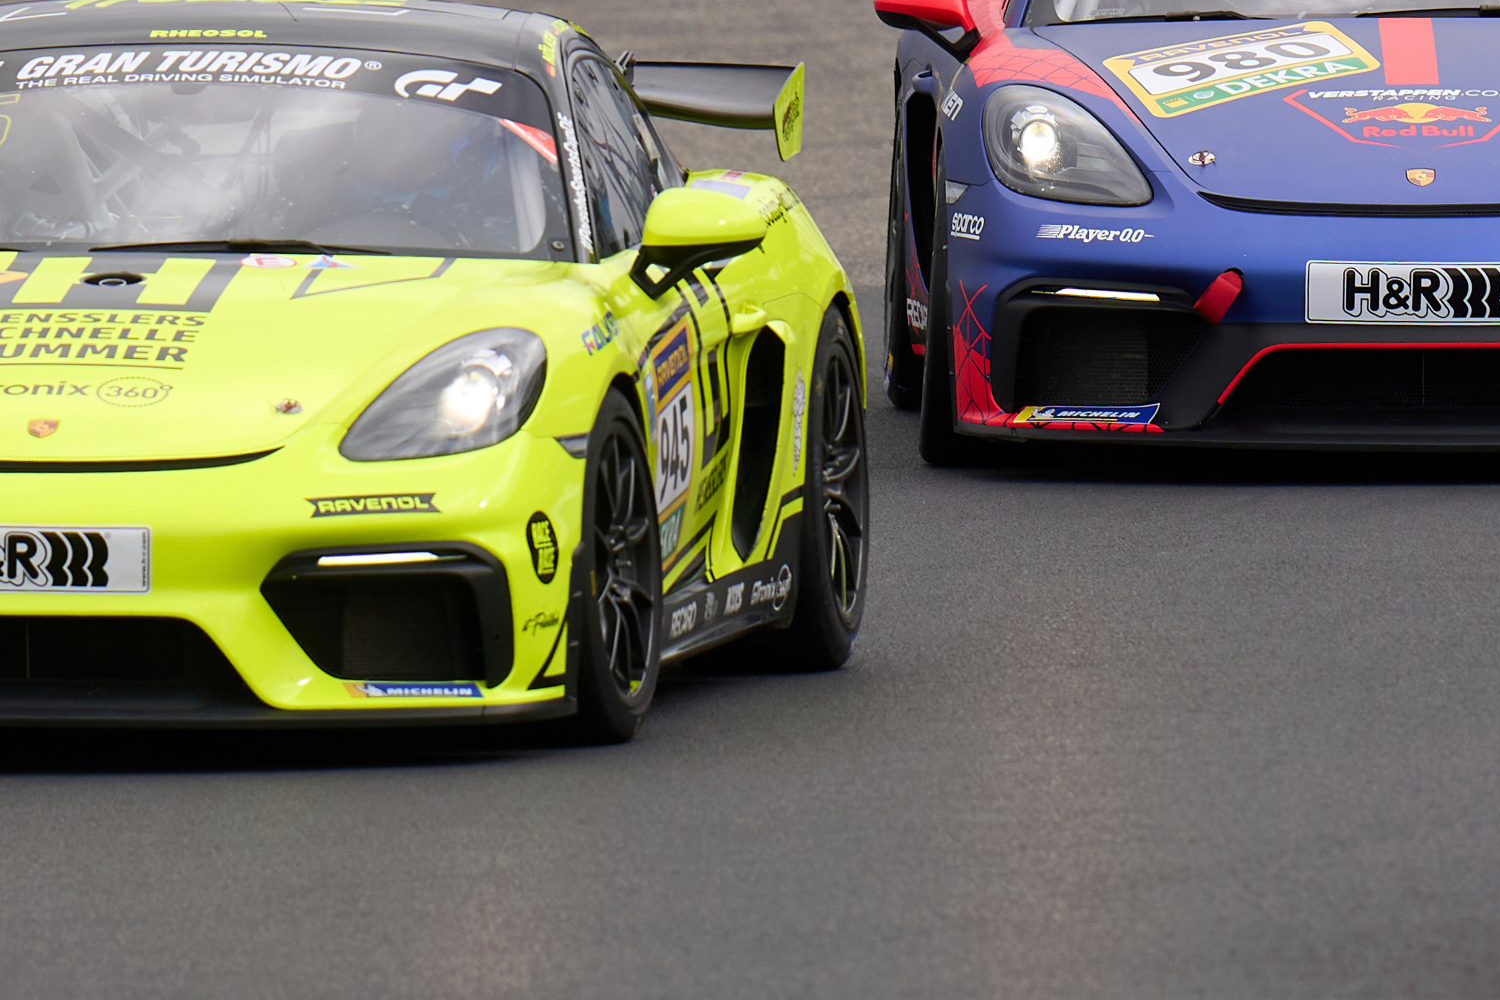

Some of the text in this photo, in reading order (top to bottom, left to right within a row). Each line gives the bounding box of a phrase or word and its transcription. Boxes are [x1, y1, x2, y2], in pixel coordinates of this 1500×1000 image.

[149, 29, 267, 38] RHEOSOL
[1140, 30, 1303, 63] RAVENOL
[16, 51, 151, 81] GRAN
[1152, 41, 1332, 83] 980
[16, 73, 346, 90] THE REAL DRIVING SIMULATOR
[1215, 60, 1359, 96] DEKRA
[1362, 125, 1475, 138] Red Bull
[951, 212, 985, 235] sparco
[1343, 268, 1443, 317] H&R
[1055, 408, 1141, 421] MICHELIN
[658, 393, 691, 504] 945
[317, 494, 430, 515] RAVENOL
[669, 602, 697, 640] RECARO
[384, 683, 474, 697] MICHELIN
